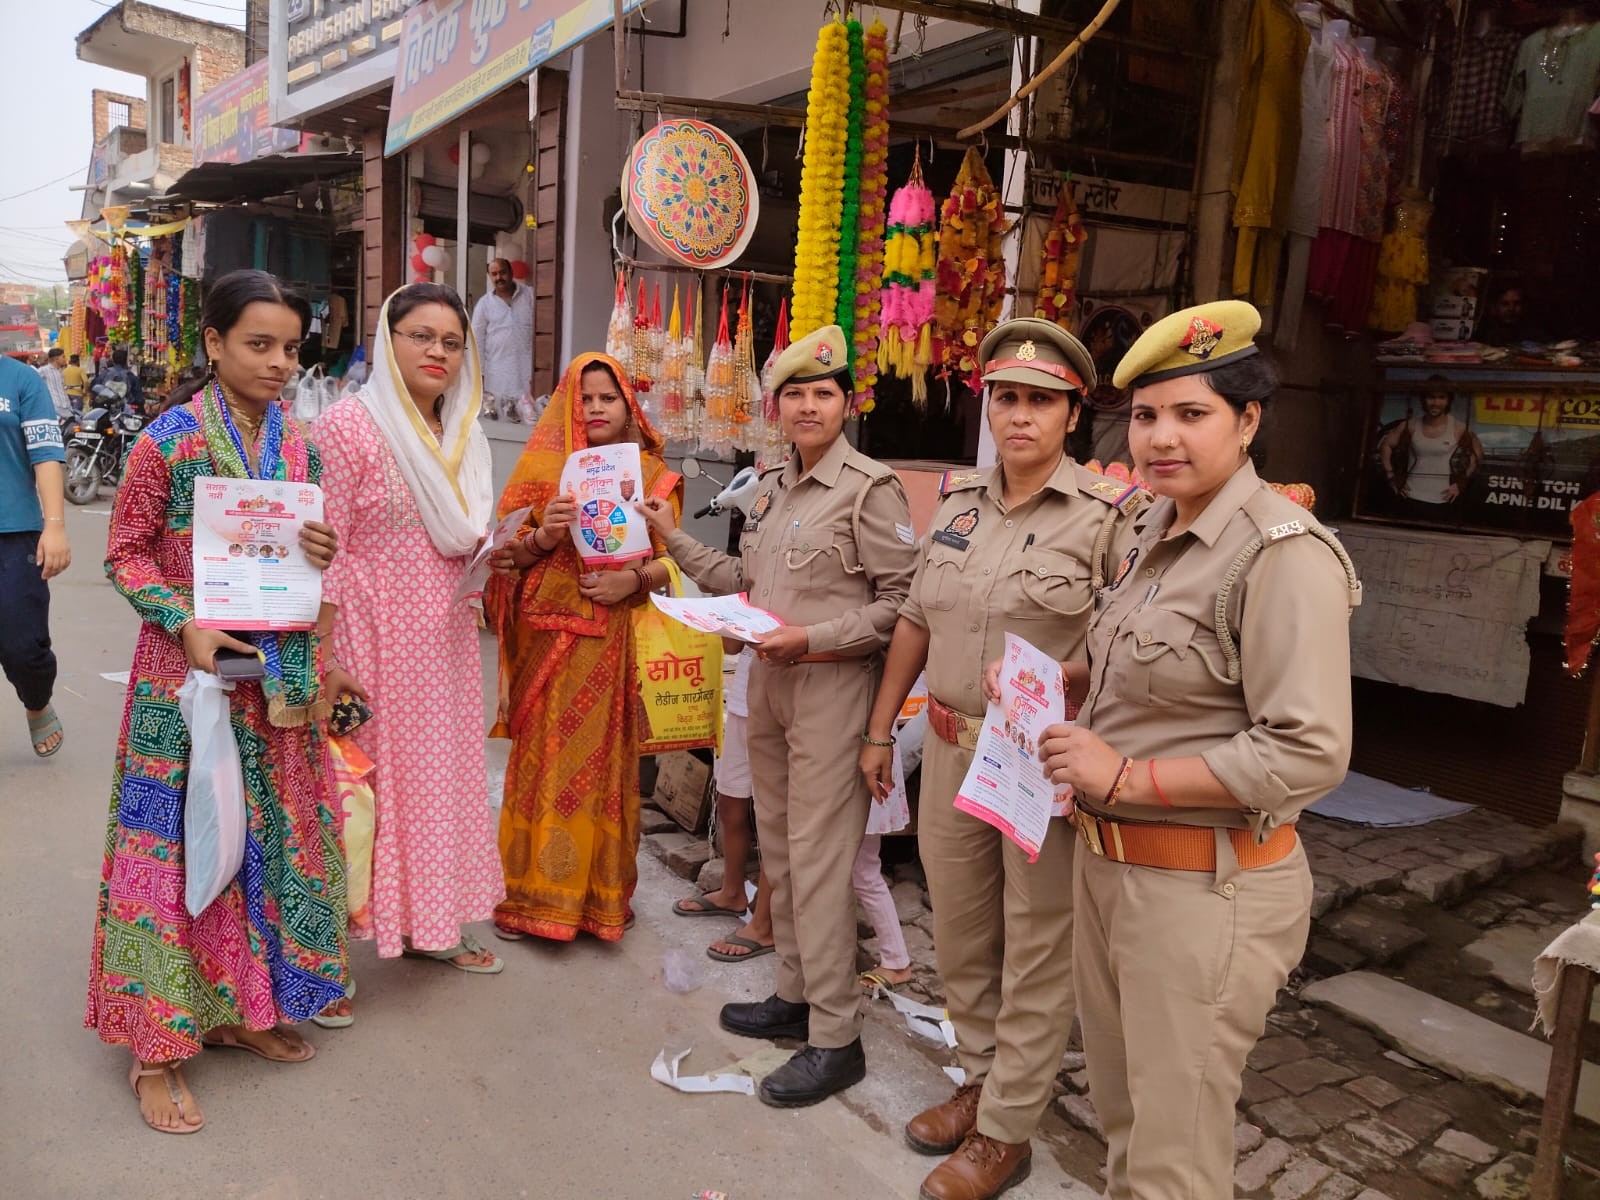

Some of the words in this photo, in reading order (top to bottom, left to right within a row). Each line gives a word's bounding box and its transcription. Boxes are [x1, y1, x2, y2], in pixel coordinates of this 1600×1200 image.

[399, 0, 464, 96] विवेक
[1085, 180, 1122, 210] स्टोर
[1488, 475, 1535, 491] SUN
[1542, 479, 1581, 496] TOH
[1536, 495, 1567, 512] DIL
[645, 652, 705, 688] सोनू
[655, 691, 679, 707] लेडीज
